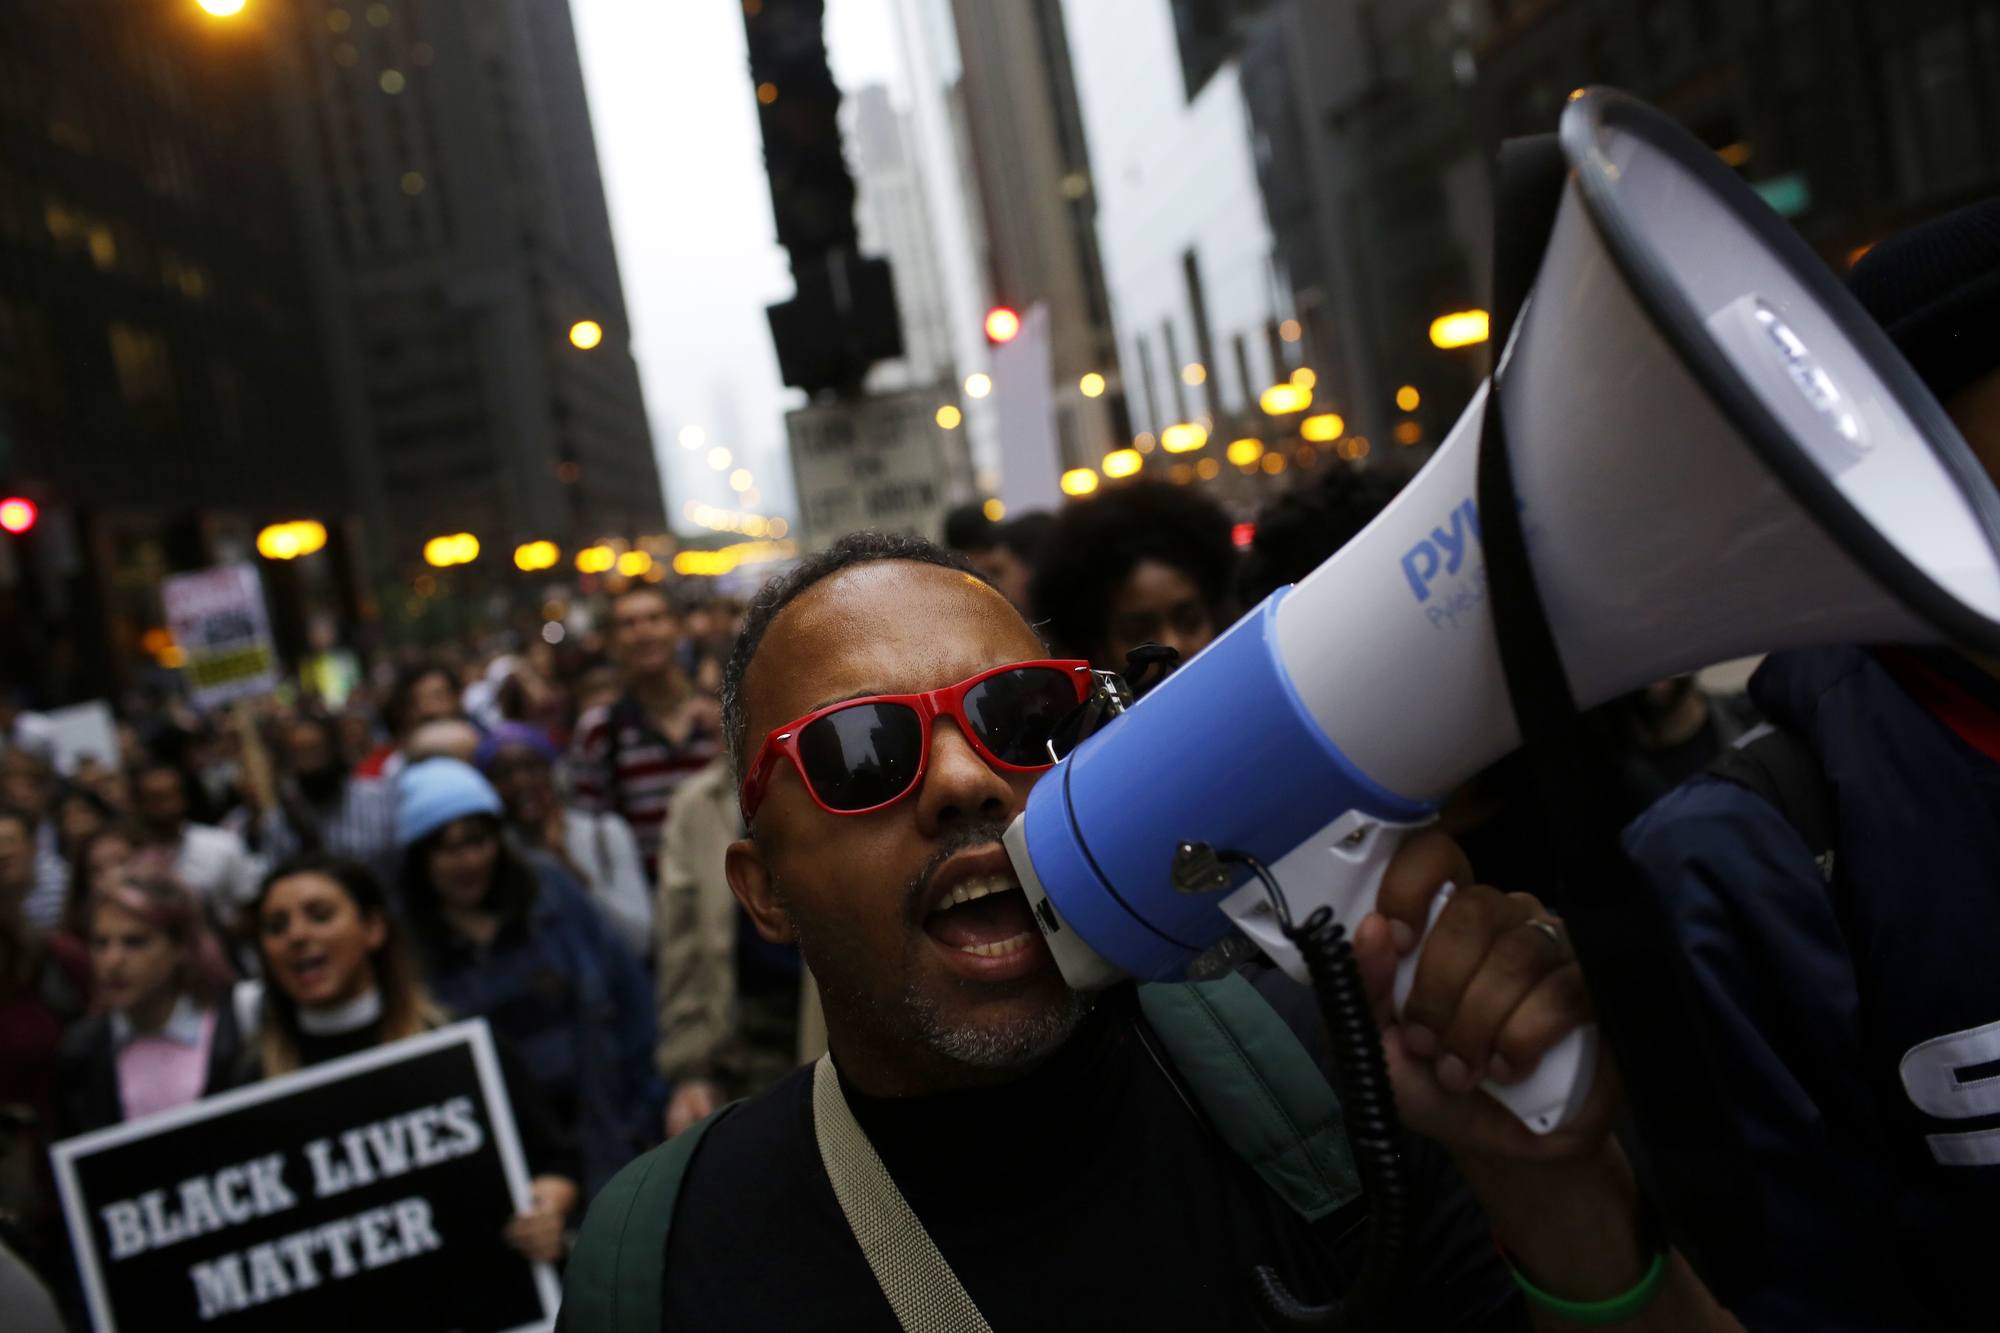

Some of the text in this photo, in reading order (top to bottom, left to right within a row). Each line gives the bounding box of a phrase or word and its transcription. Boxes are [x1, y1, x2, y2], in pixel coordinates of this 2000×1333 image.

[102, 1096, 483, 1259] BLACK LIVES
[189, 1197, 441, 1319] MATTER
